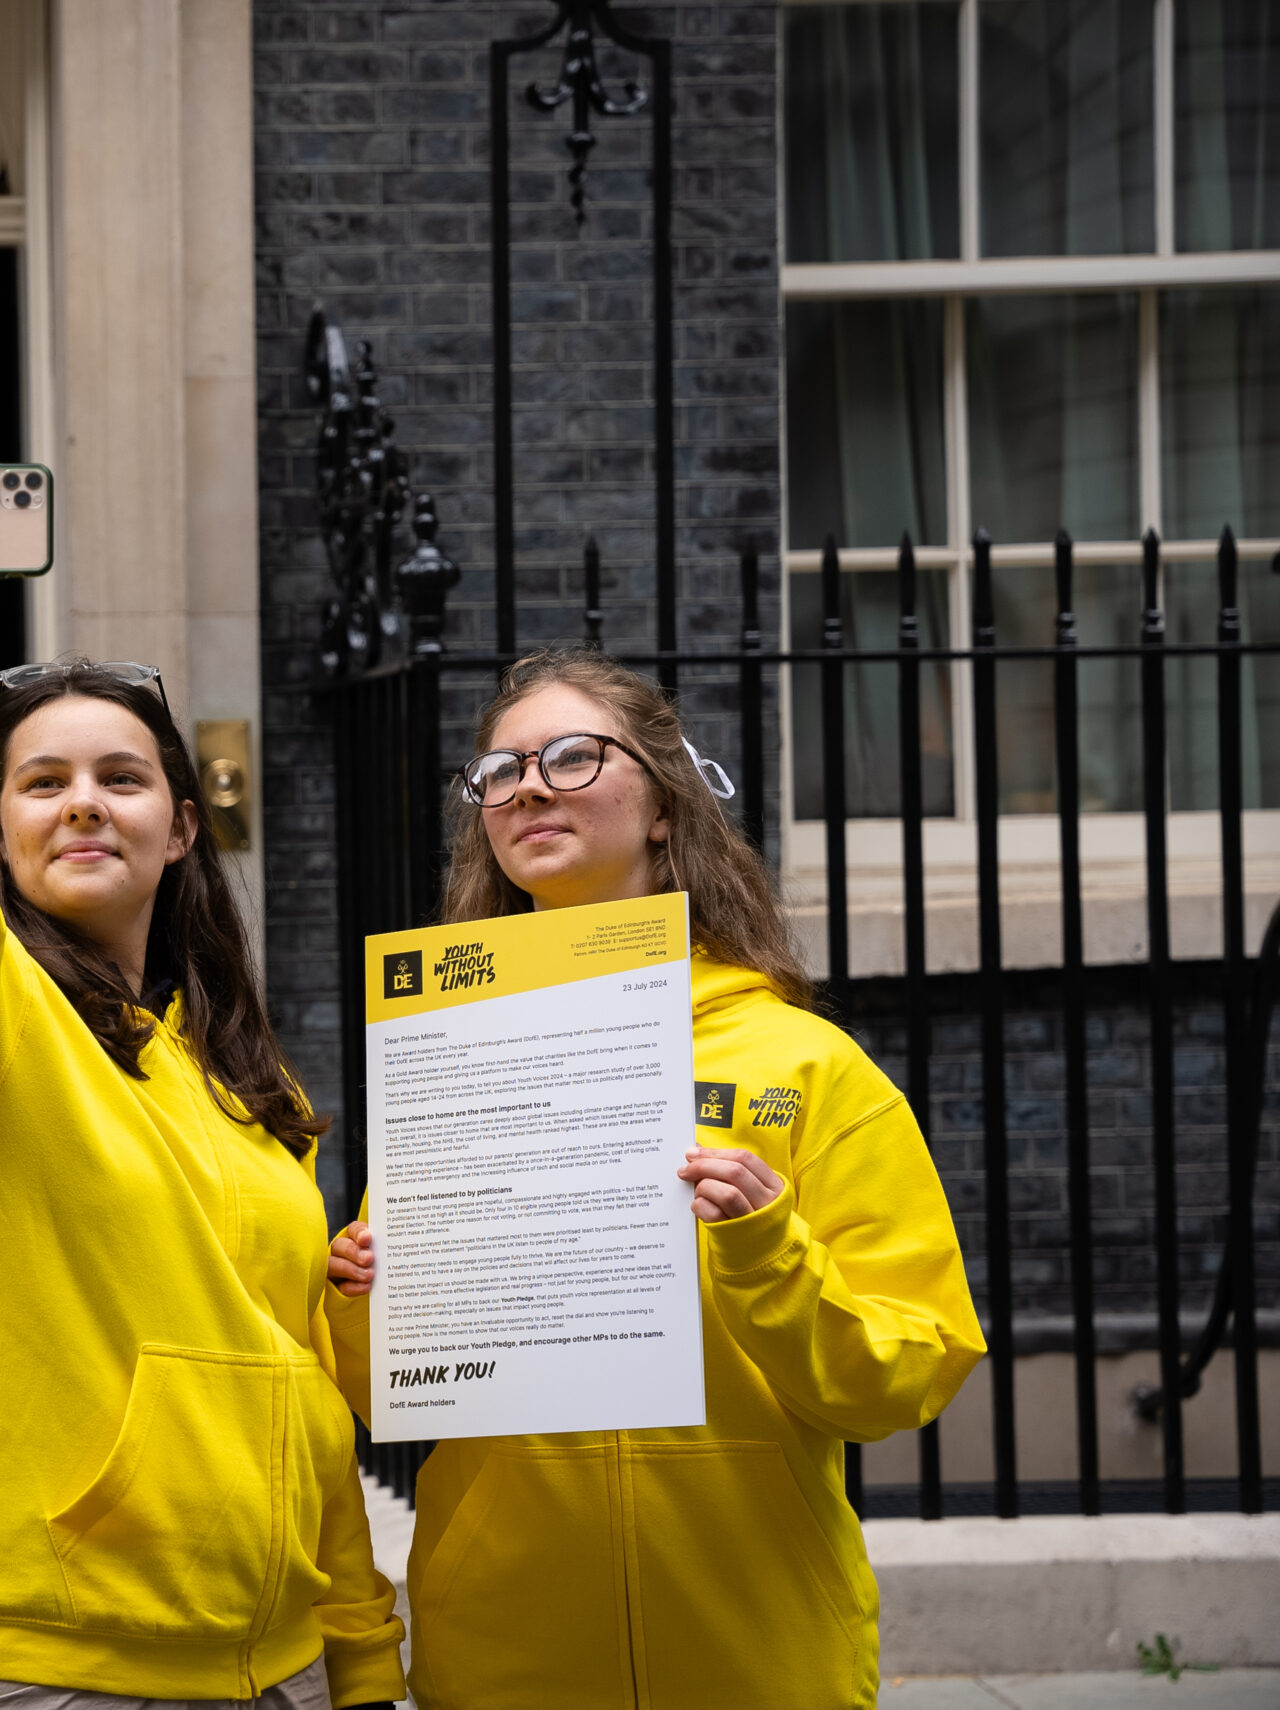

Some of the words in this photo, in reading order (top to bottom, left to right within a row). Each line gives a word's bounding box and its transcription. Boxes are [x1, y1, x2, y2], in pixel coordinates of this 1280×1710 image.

[441, 942, 484, 961] YOUTH
[434, 952, 495, 976] WITHOUT
[440, 966, 496, 992] LIMITS
[633, 982, 648, 990] July
[649, 980, 667, 988] 2024
[401, 1035, 419, 1043] Prime
[421, 1032, 448, 1040] Minister,
[541, 1031, 573, 1040] representing
[622, 1023, 640, 1031] people
[759, 1087, 802, 1102] YOUTH
[480, 1106, 498, 1114] most
[498, 1102, 532, 1113] important
[748, 1098, 802, 1115] WITHOU
[415, 1147, 442, 1155] pessimistic
[416, 1193, 430, 1201] feel
[431, 1191, 457, 1200] listened
[467, 1190, 476, 1198] by
[477, 1187, 512, 1197] politicians
[388, 1347, 400, 1355] We
[470, 1341, 491, 1349] Youth
[492, 1340, 518, 1348] Pledge,
[533, 1337, 571, 1345] encourage
[572, 1335, 592, 1343] other
[389, 1365, 450, 1389] THANK
[453, 1360, 496, 1382] YOU!
[389, 1401, 406, 1409] DofE
[407, 1400, 429, 1408] Award
